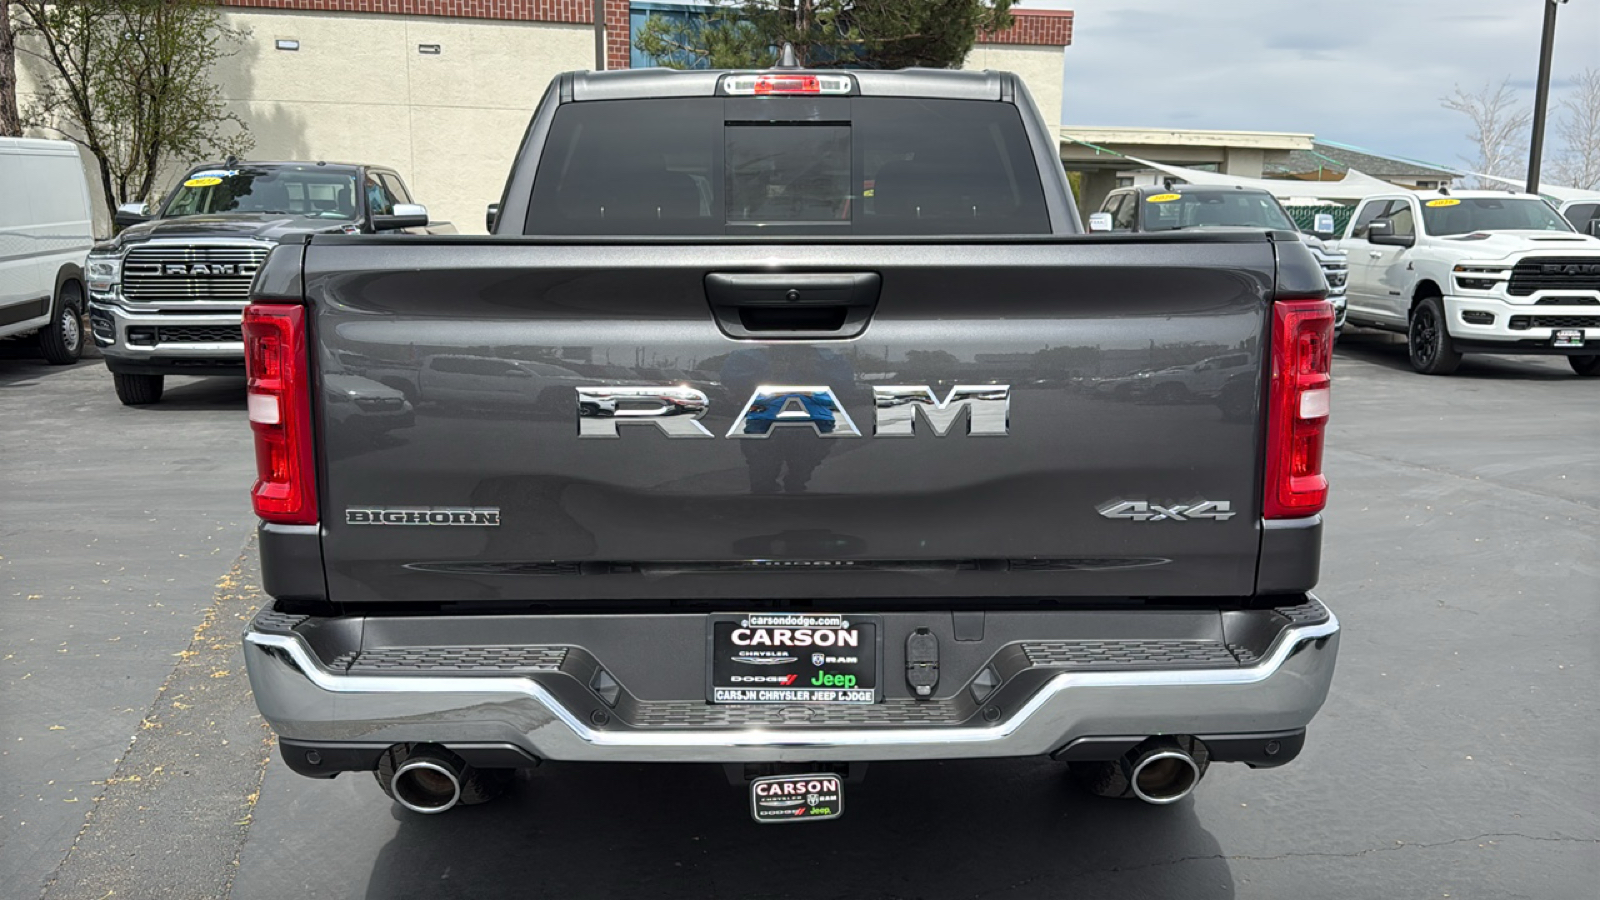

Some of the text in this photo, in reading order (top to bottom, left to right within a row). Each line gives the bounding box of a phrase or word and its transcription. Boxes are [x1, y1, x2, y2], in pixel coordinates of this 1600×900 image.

[166, 264, 234, 275] RAM
[576, 385, 1011, 439] RAM
[346, 507, 500, 526] BIGHORN
[751, 615, 840, 626] carsondodge.com
[731, 629, 858, 646] CARSON
[811, 671, 856, 688] Jeep
[759, 691, 810, 700] CHRYSLER
[811, 691, 836, 700] JEEP
[757, 781, 836, 795] CARSON
